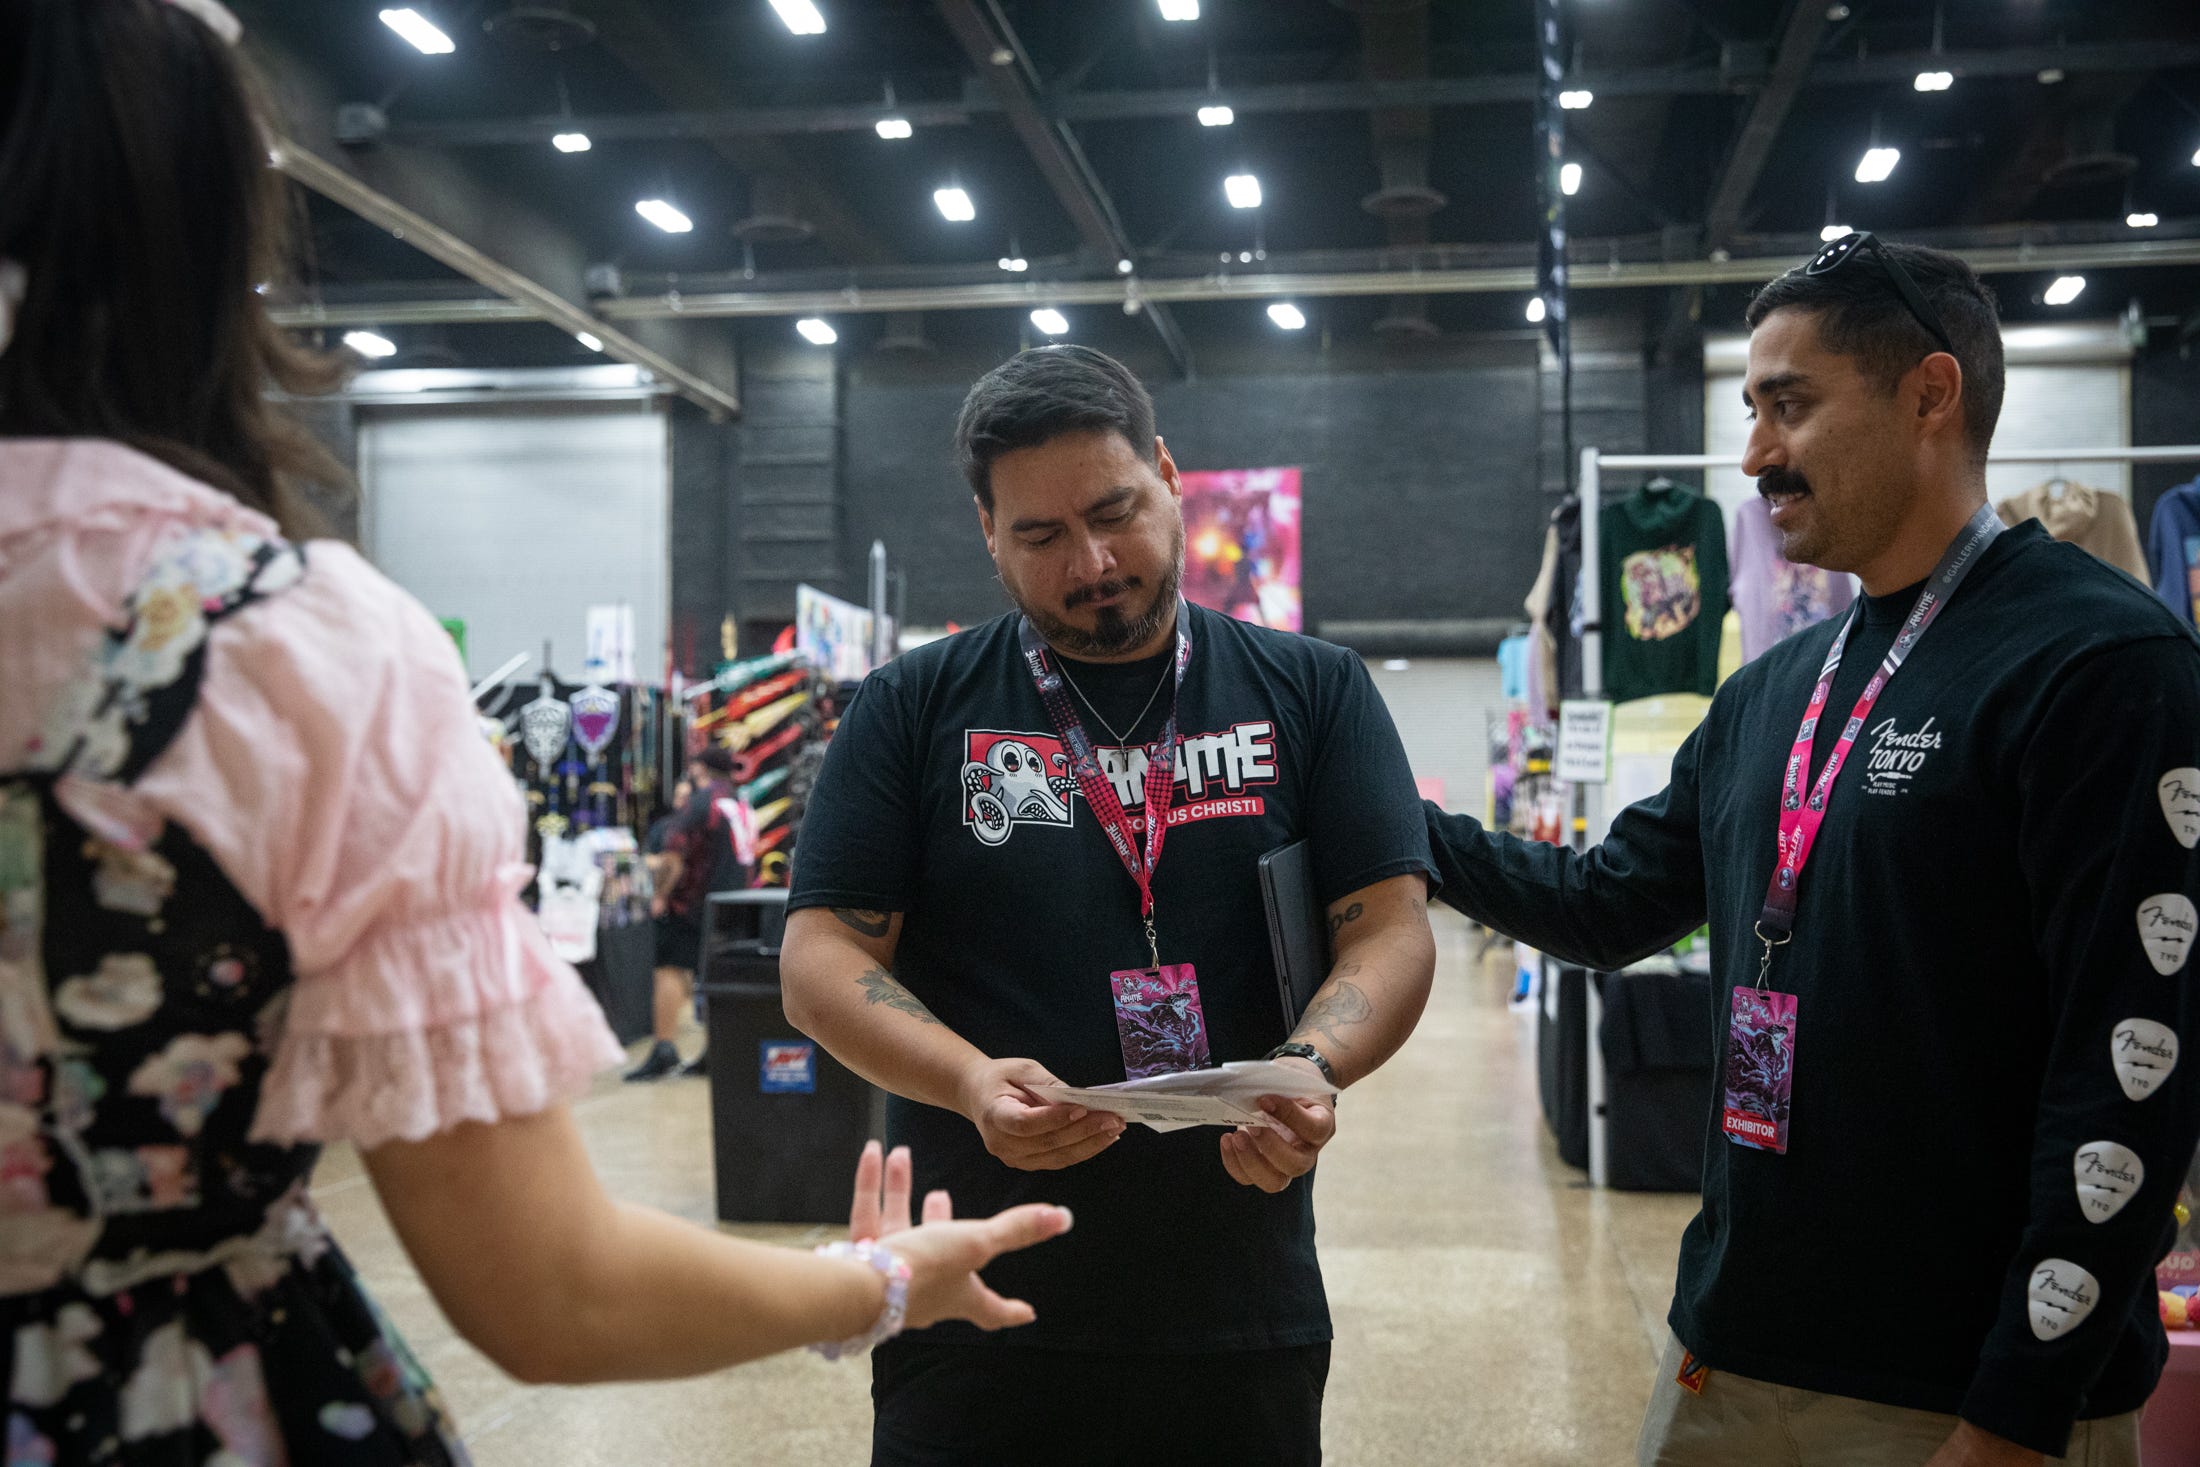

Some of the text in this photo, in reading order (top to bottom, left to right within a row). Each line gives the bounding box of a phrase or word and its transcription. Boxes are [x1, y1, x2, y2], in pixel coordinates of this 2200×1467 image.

[1870, 716, 1942, 754] Fender
[1786, 754, 1801, 788] ANIME
[1819, 752, 1840, 787] ANIME
[1867, 749, 1926, 773] TOKYO
[1191, 799, 1257, 818] CHRISTI
[2116, 1029, 2173, 1060] Fender
[1726, 1115, 1776, 1138] EXHIBITOR
[2079, 1151, 2136, 1184] Fender
[2037, 1269, 2092, 1306] Fender
